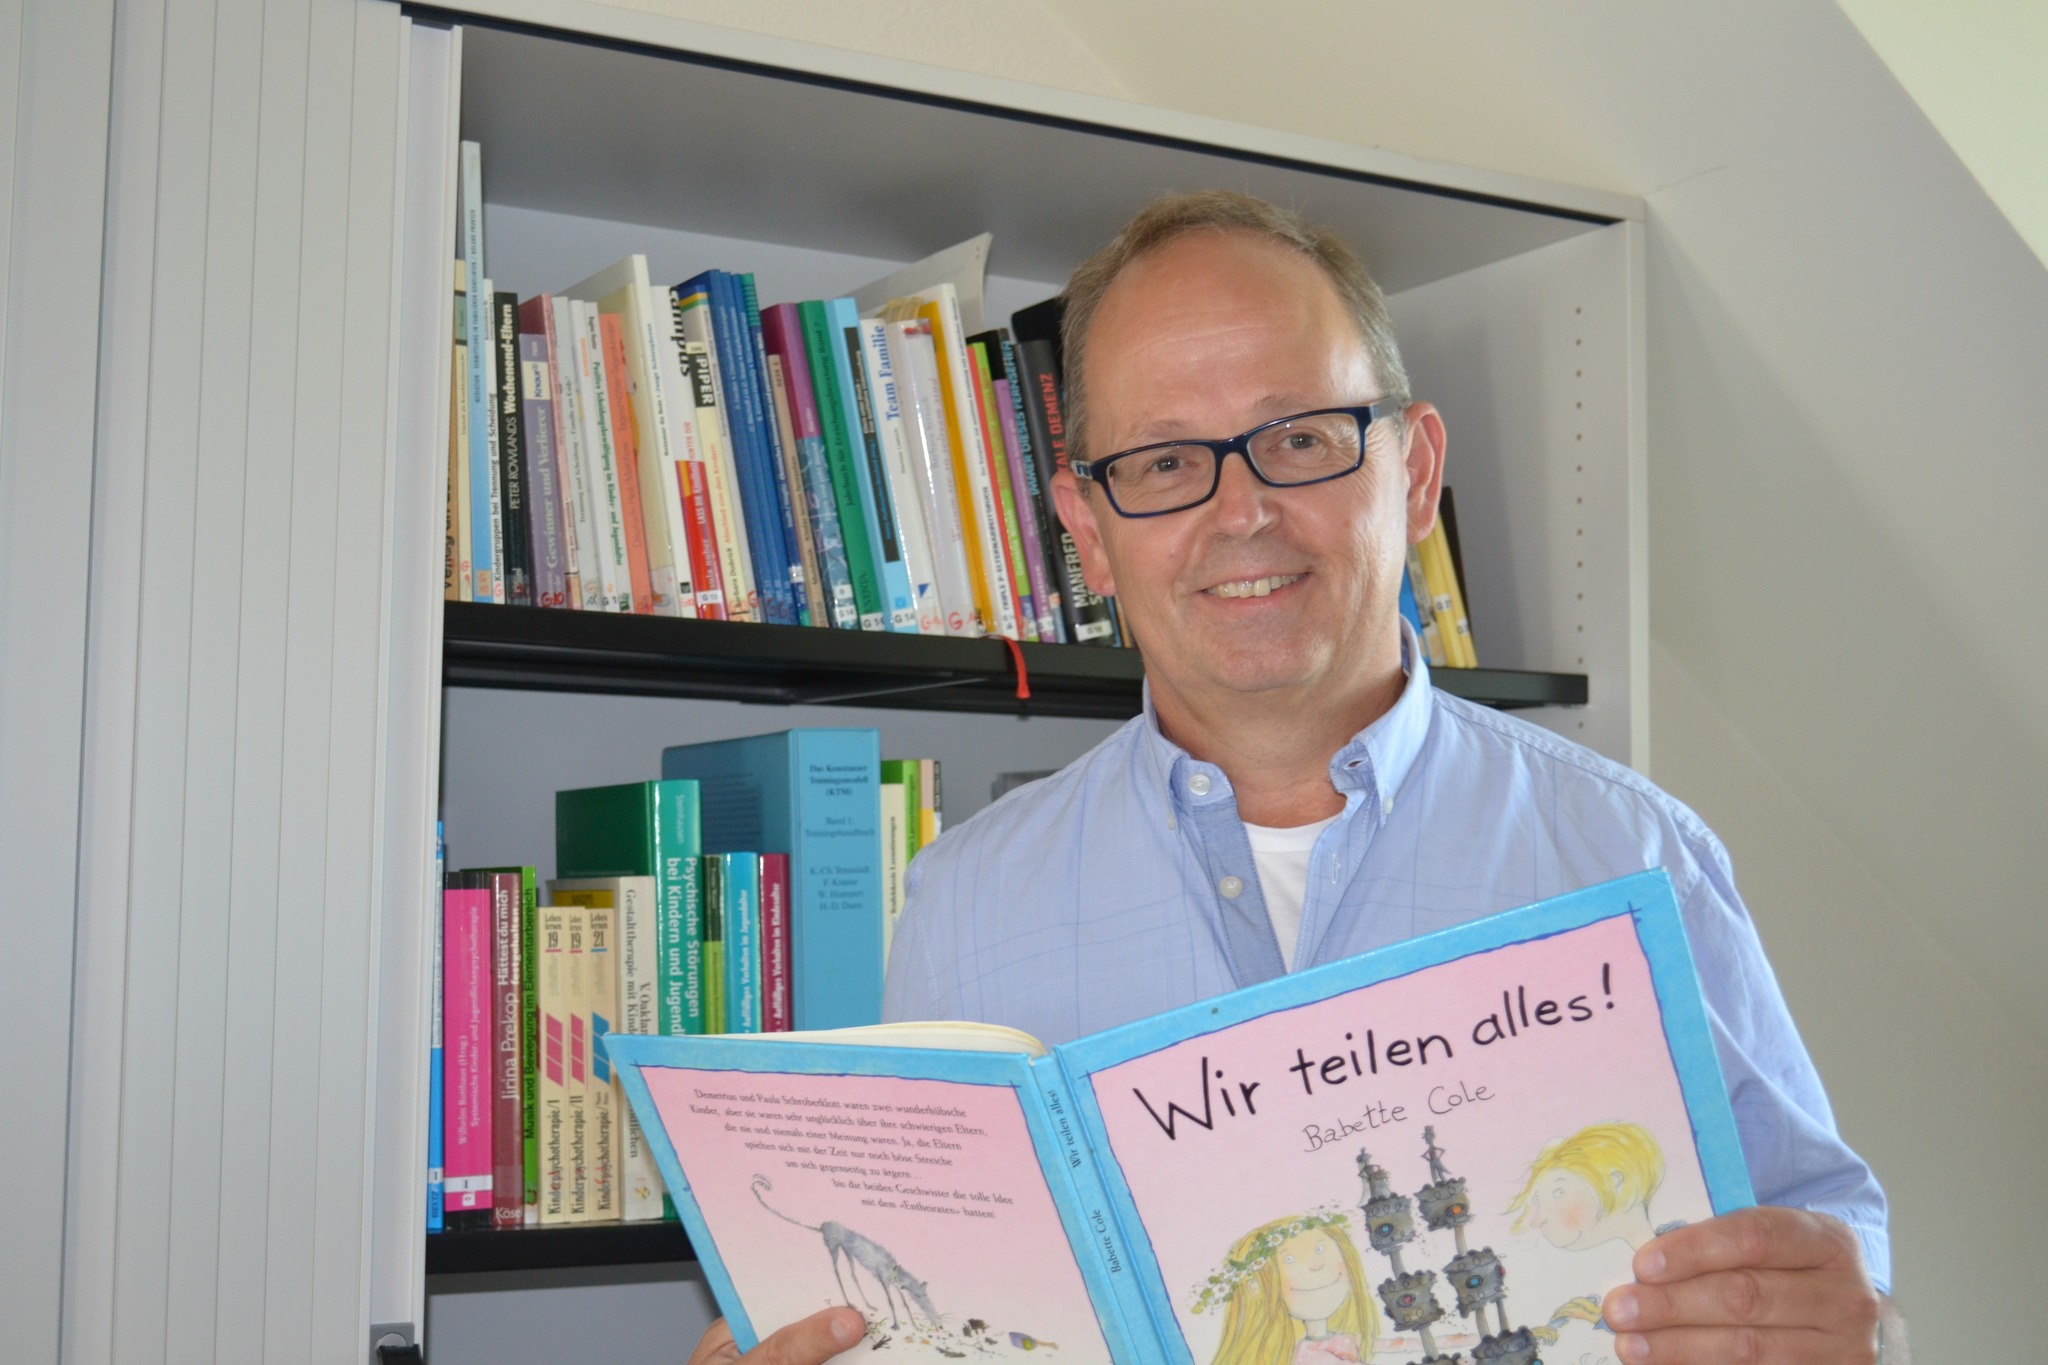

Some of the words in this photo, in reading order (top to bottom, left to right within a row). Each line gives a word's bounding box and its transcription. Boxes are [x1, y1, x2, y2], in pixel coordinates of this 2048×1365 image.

[670, 286, 690, 377] campus
[500, 303, 516, 415] Wochenend-Eltern
[871, 325, 893, 378] Familie
[593, 361, 601, 388] Positive
[696, 355, 714, 406] PIPER
[1002, 340, 1022, 409] FERNSEHEN
[486, 392, 498, 438] Scheidung
[886, 383, 900, 420] Team
[1040, 372, 1063, 434] DEMENZ
[537, 407, 550, 466] Verlierer
[596, 392, 611, 470] Scheidungsbewältigung
[683, 421, 692, 433] DIR
[1014, 412, 1030, 453] DIESES
[488, 440, 497, 457] und
[506, 417, 518, 478] ROWLANDS
[488, 459, 500, 499] Trennung
[540, 468, 553, 496] und
[1022, 454, 1039, 496] IMMER
[508, 478, 520, 510] PETER
[694, 493, 703, 506] DIE
[544, 494, 558, 568] Gewinner
[610, 511, 619, 524] und
[696, 506, 706, 524] LASS
[490, 517, 503, 582] Kindergruppen
[611, 526, 622, 565] Jugendalter
[1061, 533, 1088, 608] MANFRED
[810, 776, 868, 786] Trainingsmodell
[826, 788, 852, 796] (KTM)
[676, 794, 685, 843] Steinhausen
[806, 829, 875, 838] Trainingshandbuch
[667, 857, 681, 880] bei
[497, 890, 508, 919] mich
[668, 885, 682, 942] Kindern
[682, 857, 698, 935] Psychische
[739, 890, 750, 932] Jugendalter
[771, 884, 780, 925] Kindesalter
[497, 922, 508, 936] du
[511, 908, 520, 984] festgehalten
[522, 889, 534, 991] Elementarbereich
[594, 932, 604, 947] 21
[625, 889, 636, 976] Gestalttherapie
[741, 935, 749, 945] im
[772, 927, 781, 937] im
[470, 907, 479, 1022] Jugendlichenpsychotherapie
[498, 939, 508, 985] Hättest
[669, 948, 683, 975] und
[741, 947, 750, 983] Verhalten
[772, 938, 781, 975] Verhalten
[627, 980, 636, 999] mit
[686, 940, 700, 1017] Störungen
[523, 994, 533, 1008] im
[741, 986, 752, 1026] Auffälliges
[773, 978, 783, 1018] Auffälliges
[502, 992, 518, 1051] Prekop
[459, 1035, 468, 1066] (Hrsg.)
[524, 1011, 536, 1075] Bewegung
[1132, 1056, 1260, 1140] Wir
[1290, 1030, 1453, 1095] teilen
[1472, 962, 1615, 1046] alles!
[502, 1057, 519, 1100] Jirina
[524, 1077, 534, 1100] und
[471, 1075, 479, 1126] Systemische
[694, 1089, 737, 1100] Demetrius
[740, 1094, 755, 1102] und
[757, 1094, 780, 1104] Paula
[896, 1105, 967, 1118] wunderhübsche
[1045, 1088, 1064, 1116] alles!
[1302, 1103, 1408, 1152] Babette
[1427, 1080, 1495, 1116] Cole
[524, 1104, 534, 1138] Musik
[690, 1104, 720, 1116] Kinder,
[725, 1108, 742, 1118] aber
[746, 1110, 756, 1118] sie
[786, 1113, 802, 1122] sehr
[806, 1114, 854, 1126] unglücklich
[858, 1118, 876, 1128] über
[880, 1118, 898, 1128] ihre
[900, 1120, 953, 1134] schwierigen
[955, 1124, 988, 1136] Eltern,
[725, 1123, 737, 1132] die
[740, 1124, 752, 1133] nie
[755, 1126, 770, 1134] und
[773, 1127, 803, 1137] niemals
[806, 1130, 826, 1139] einer
[830, 1132, 868, 1144] Meinung
[871, 1137, 898, 1145] waren.
[902, 1136, 914, 1148] Ja,
[918, 1139, 930, 1148] die
[933, 1139, 962, 1150] Eltern
[1058, 1117, 1074, 1146] teilen
[548, 1100, 561, 1214] Kinderpsychotherapie/I
[745, 1142, 776, 1152] spielten
[779, 1143, 795, 1152] sich
[798, 1144, 810, 1153] mit
[814, 1146, 827, 1154] der
[829, 1146, 848, 1157] Zeit
[869, 1152, 890, 1160] noch
[892, 1153, 913, 1162] böse
[916, 1154, 953, 1166] Streiche
[786, 1160, 798, 1168] um
[801, 1161, 817, 1170] sich
[820, 1164, 866, 1176] gegenseitig
[883, 1170, 912, 1179] ärgern
[1068, 1148, 1082, 1168] Wir
[833, 1179, 846, 1188] bis
[849, 1180, 861, 1189] die
[864, 1181, 893, 1192] beiden
[896, 1184, 950, 1198] Geschwister
[953, 1189, 966, 1199] die
[970, 1191, 990, 1202] tolle
[993, 1193, 1014, 1204] Idee
[862, 1197, 875, 1206] mit
[878, 1198, 896, 1208] dem
[963, 1206, 996, 1218] hatten!
[1090, 1209, 1106, 1234] Cole
[1101, 1236, 1121, 1273] Babette
